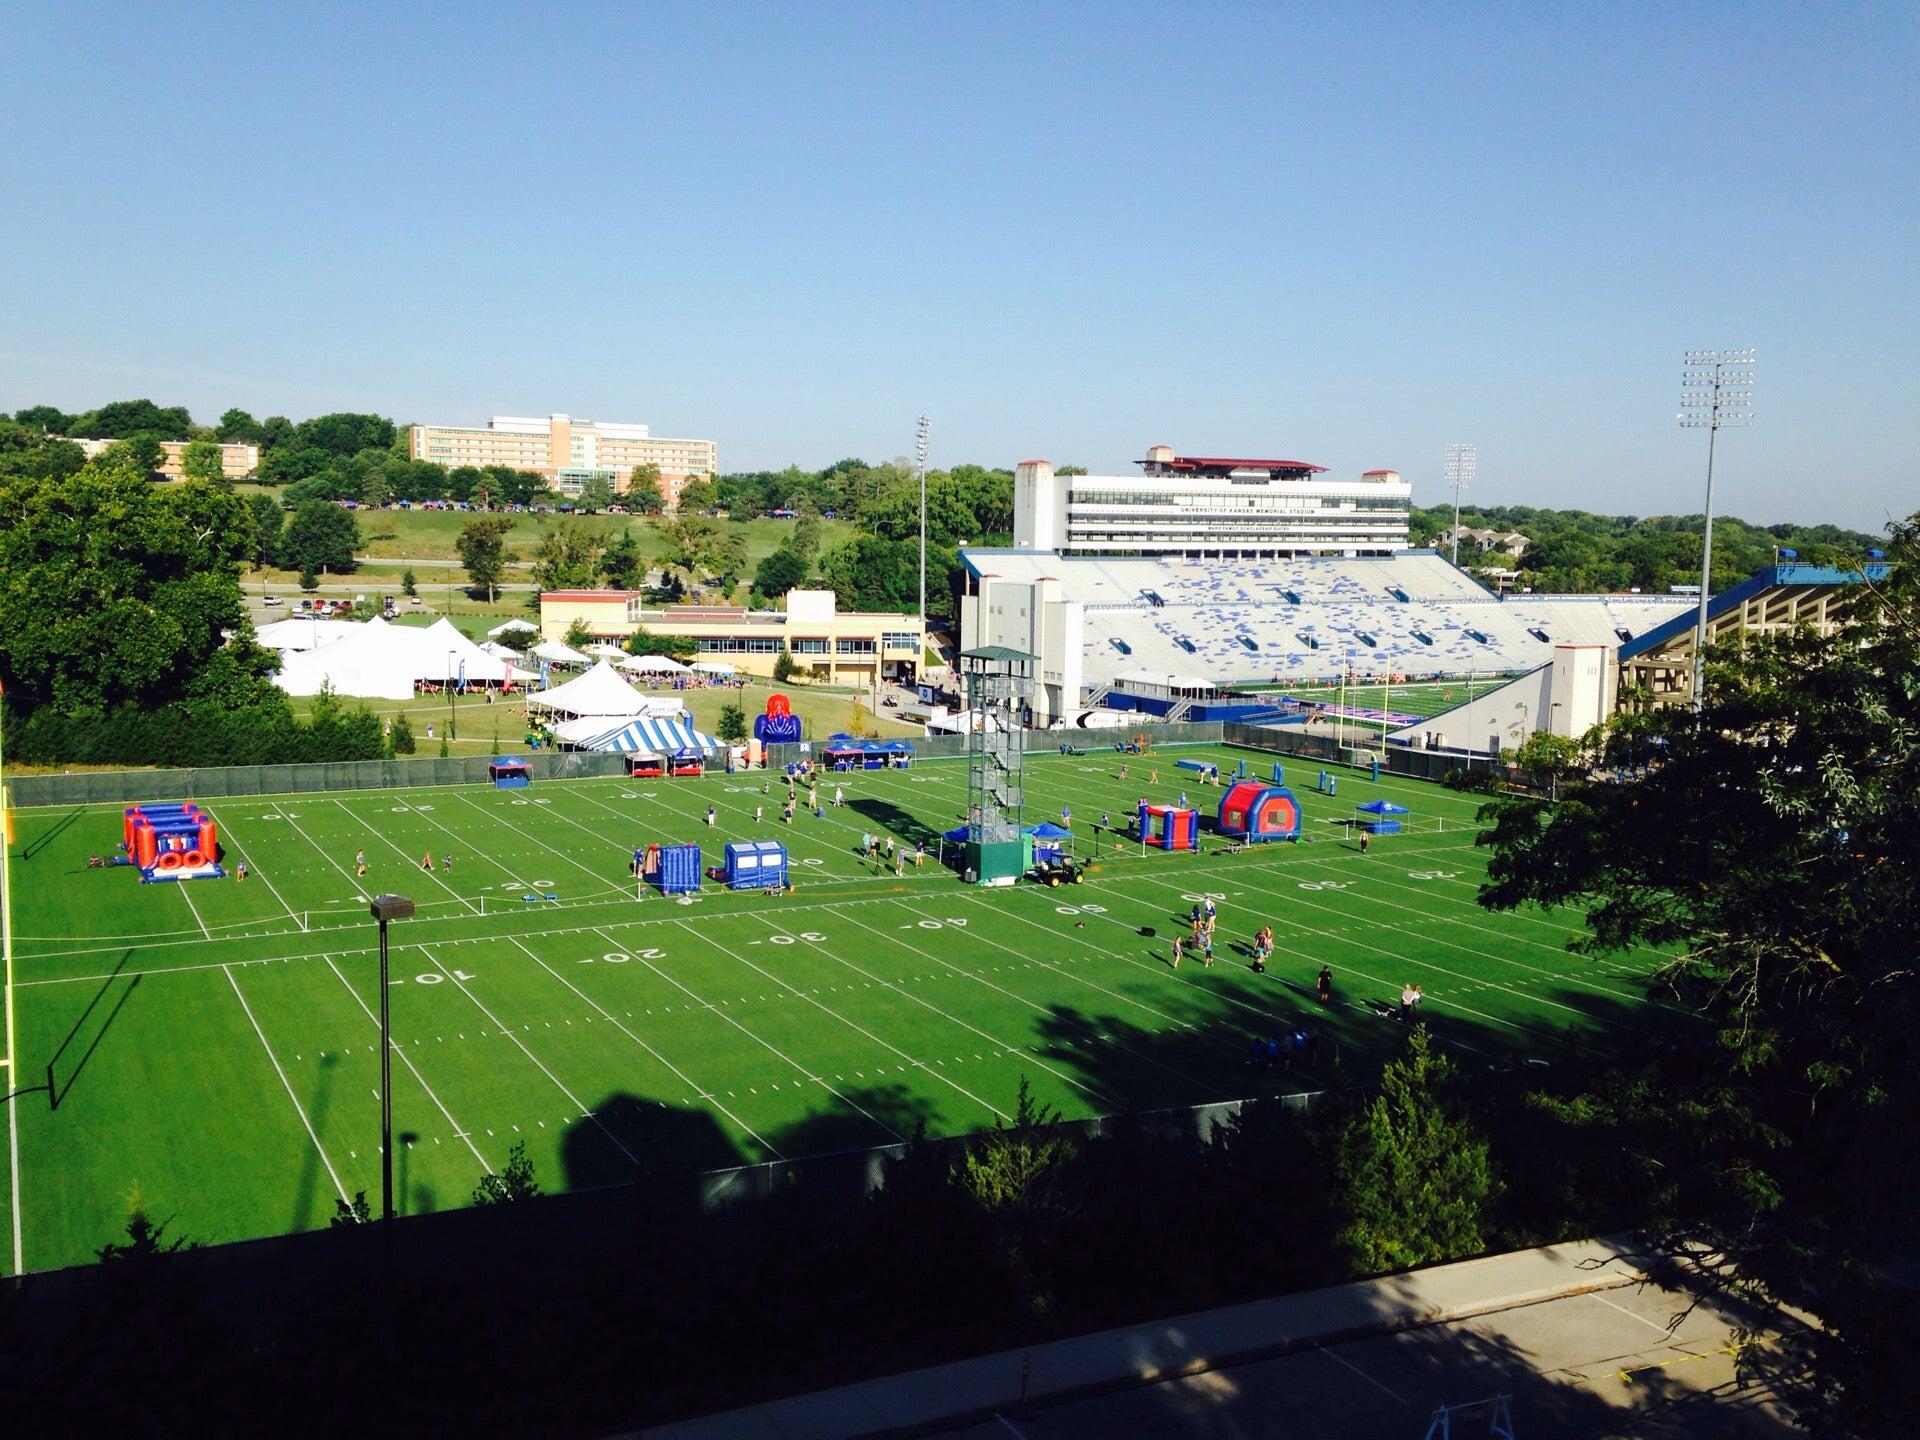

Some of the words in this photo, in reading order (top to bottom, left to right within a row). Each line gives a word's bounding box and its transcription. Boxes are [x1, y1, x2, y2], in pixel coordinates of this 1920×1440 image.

[500, 880, 556, 891] 20
[918, 918, 968, 929] 40
[769, 932, 827, 945] 30
[602, 948, 667, 963] 20
[415, 970, 476, 985] 10
